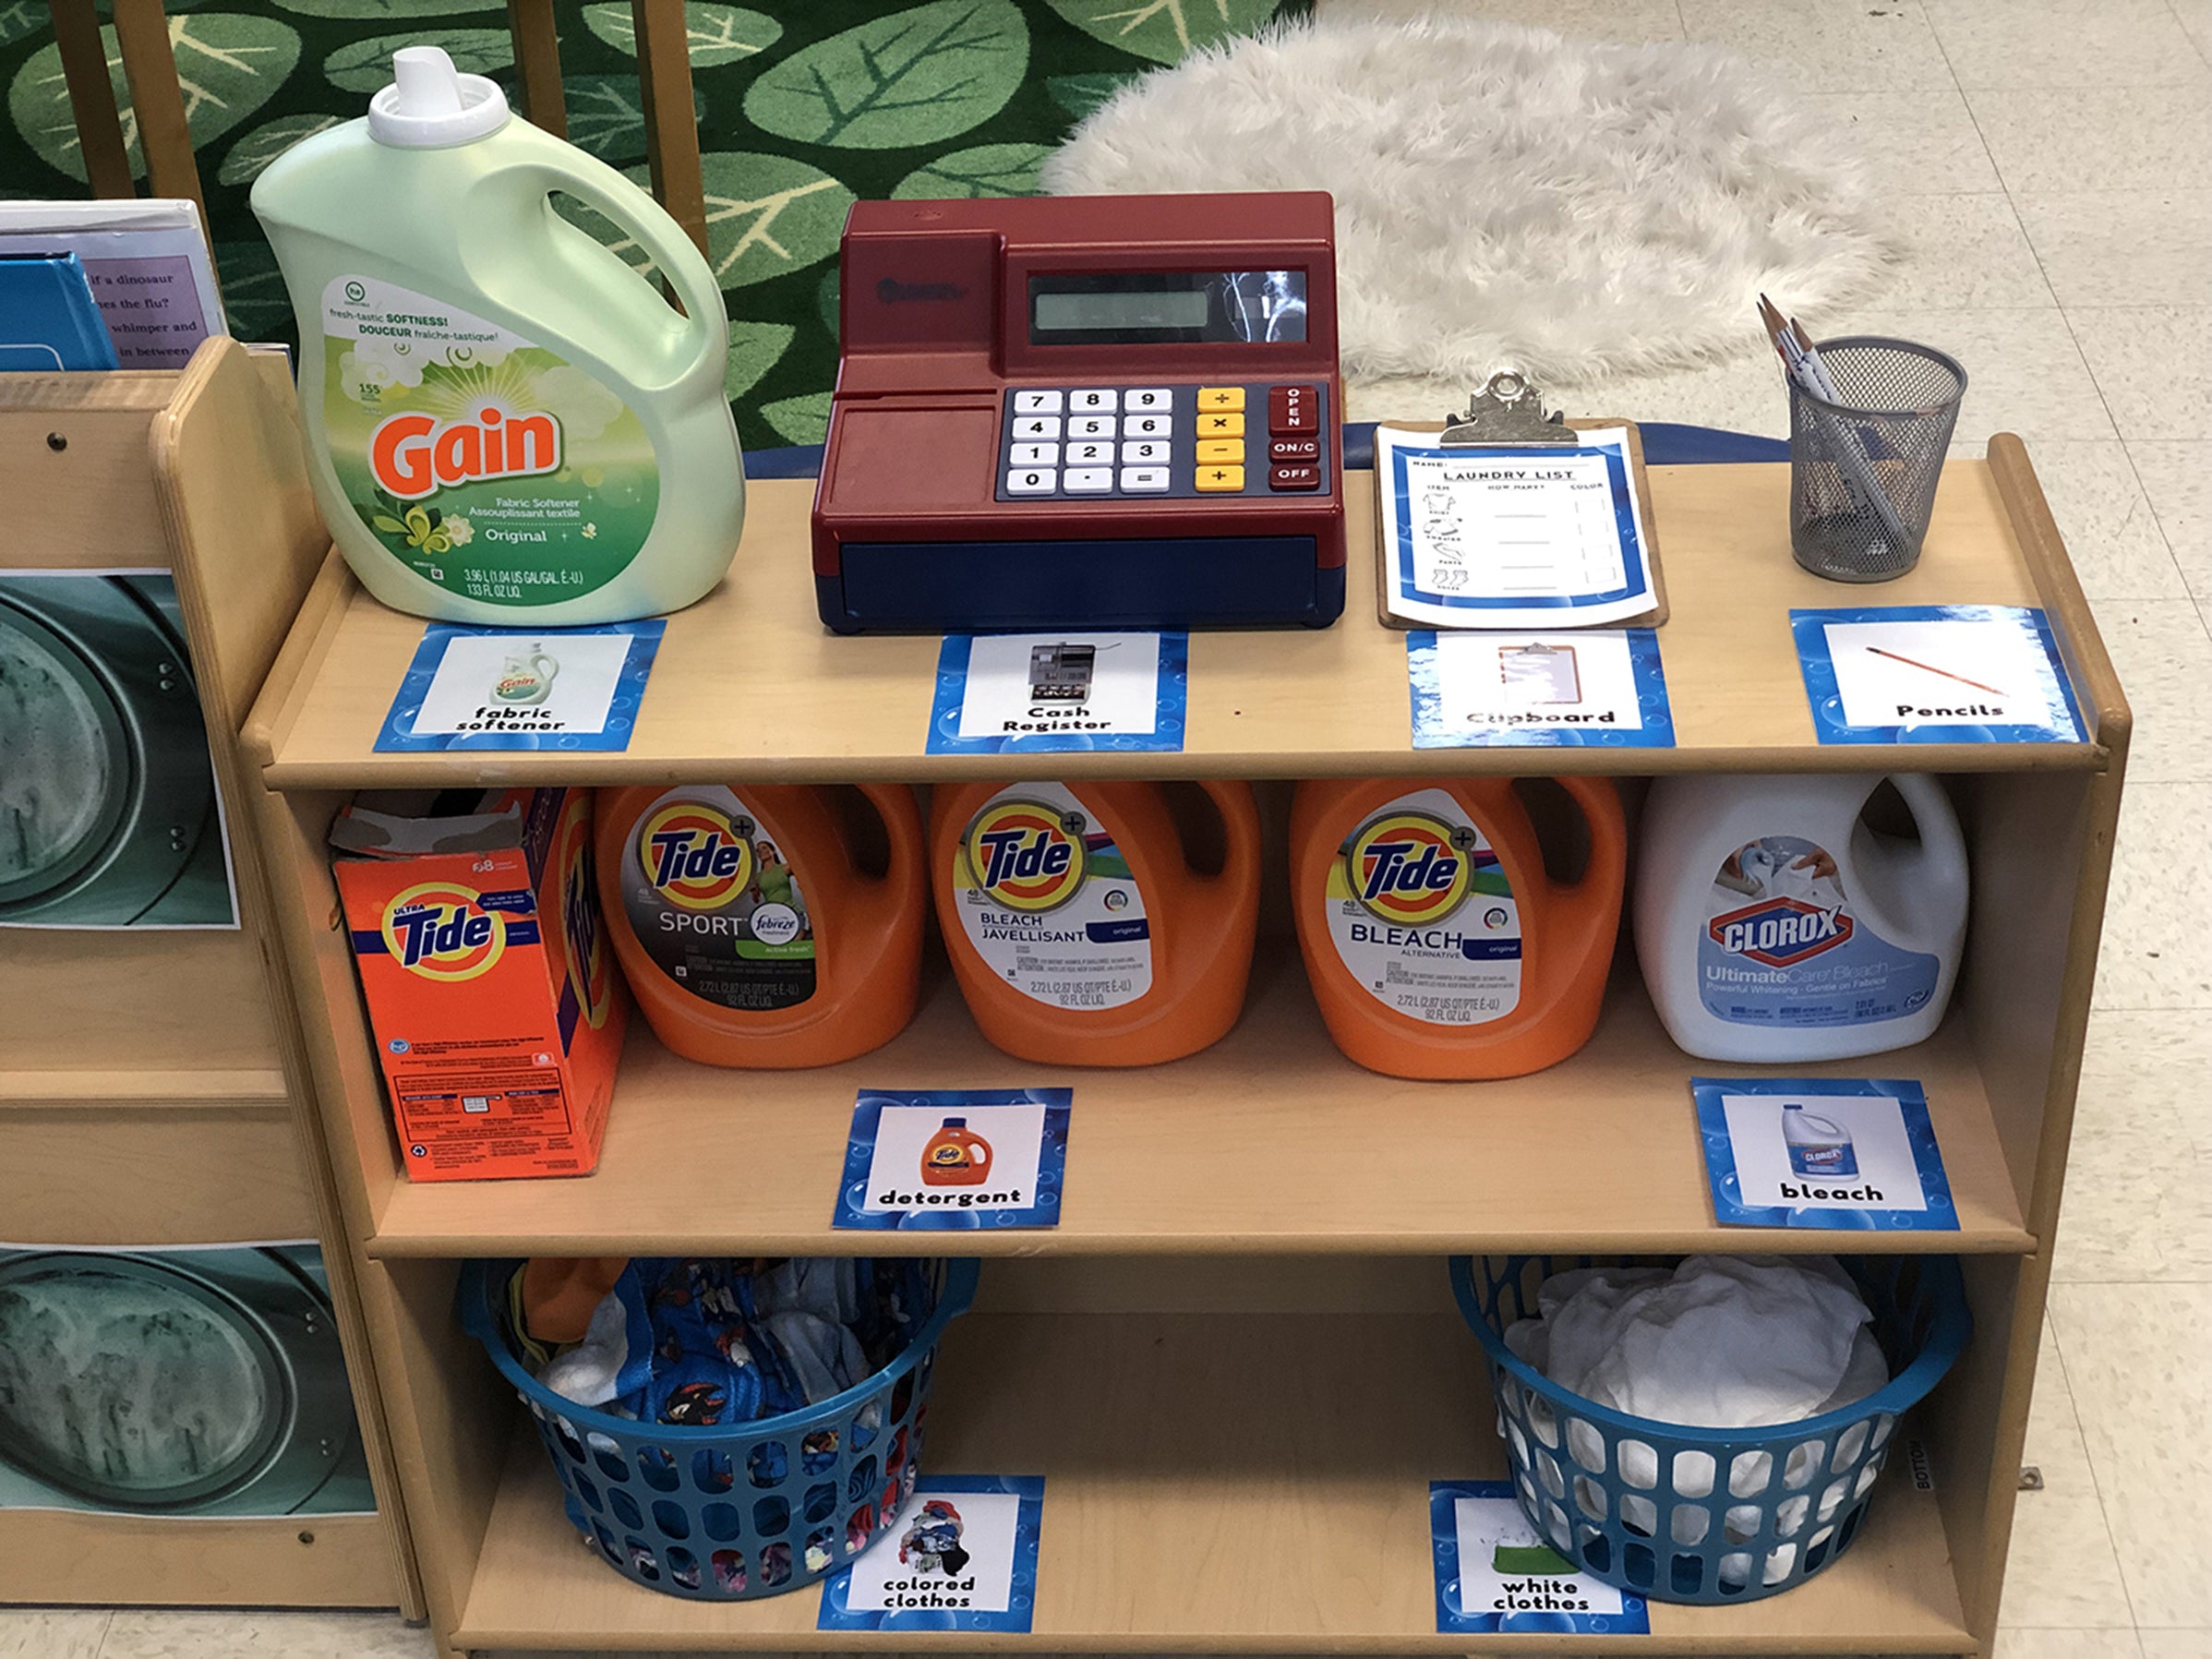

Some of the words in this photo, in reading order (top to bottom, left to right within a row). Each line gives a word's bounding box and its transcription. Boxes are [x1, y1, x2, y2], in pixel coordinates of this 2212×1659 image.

[104, 277, 114, 285] a
[116, 274, 174, 285] dinosaur
[120, 299, 139, 309] the
[144, 298, 169, 309] flu?
[330, 308, 384, 323] fresh-tastic
[386, 313, 449, 327] SOFTNESS!
[112, 323, 169, 334] whimper
[173, 321, 197, 331] and
[358, 324, 413, 338] DOUCEUR
[120, 347, 133, 357] in
[136, 346, 190, 357] between
[359, 383, 381, 395] 155
[1031, 396, 1044, 407] 7
[1087, 394, 1100, 405] 8
[1141, 394, 1155, 405] 9
[1287, 388, 1301, 427] OPEN
[1029, 422, 1043, 433] 4
[1086, 421, 1099, 433] 5
[1142, 420, 1155, 432] 6
[372, 407, 555, 496] Gain
[1029, 448, 1040, 459] 1
[1083, 446, 1097, 458] 2
[1139, 446, 1153, 457] 3
[1274, 442, 1315, 453] ON/C
[1026, 474, 1040, 486] 0
[1278, 468, 1310, 479] OFF
[1443, 471, 1526, 481] LAUNDRY
[1535, 471, 1573, 480] LIST
[496, 497, 530, 509] Fabric
[533, 497, 581, 509] Softener
[469, 507, 545, 519] Assouplissant
[546, 507, 581, 519] textile
[485, 528, 547, 545] Original
[499, 677, 535, 690] Gain
[475, 707, 552, 719] fabric
[1028, 706, 1090, 718] Cash
[1896, 704, 2004, 717] Pencils
[456, 718, 566, 731] softener
[1003, 720, 1112, 733] Register
[650, 831, 740, 889] Tide
[980, 830, 1072, 889] Tide
[1363, 842, 1460, 901] Tide
[393, 903, 426, 916] ULTRA
[659, 911, 744, 936] SPORT
[755, 914, 796, 932] febreze
[980, 912, 1042, 926] BLEACH
[982, 928, 1085, 943] JAVELLISANT
[1112, 925, 1142, 935] original
[1723, 904, 1843, 954] CLOROX
[391, 906, 493, 968] Tide
[1350, 923, 1462, 949] BLEACH
[1401, 949, 1461, 959] ALTERNATIVE
[1833, 961, 1889, 980] Bleach
[1707, 982, 1749, 994] Powerful
[1749, 982, 1798, 995] Whitening
[1805, 982, 1837, 993] Gentle
[879, 1189, 1021, 1208] detergent
[1780, 1183, 1883, 1201] bleach
[884, 1577, 975, 1592] colored
[1501, 1578, 1578, 1594] white
[884, 1593, 970, 1608] clothes
[1493, 1594, 1590, 1611] clothes
